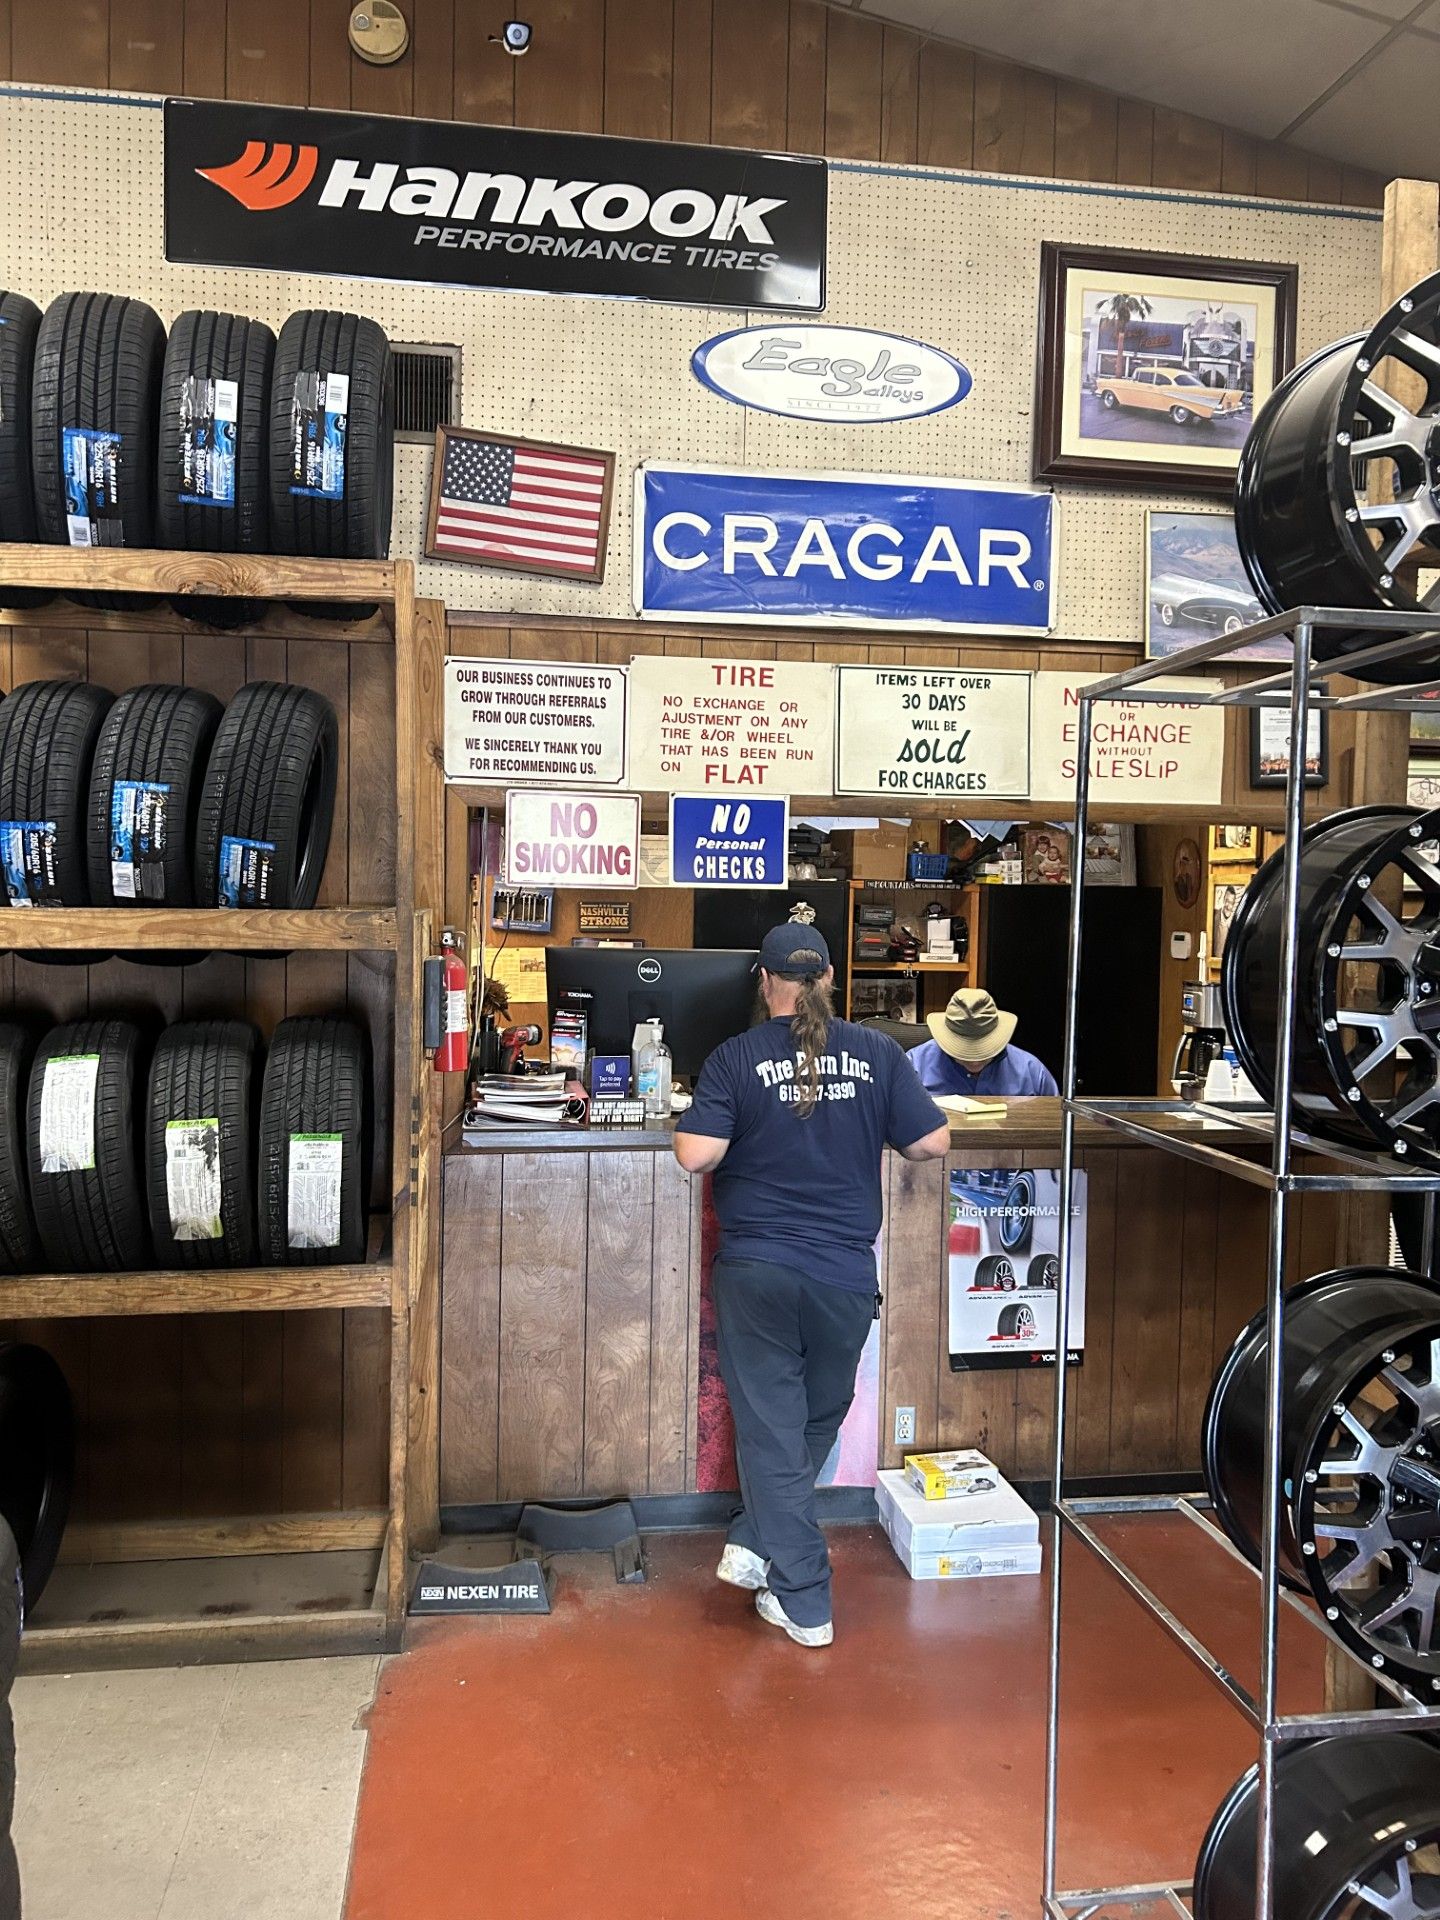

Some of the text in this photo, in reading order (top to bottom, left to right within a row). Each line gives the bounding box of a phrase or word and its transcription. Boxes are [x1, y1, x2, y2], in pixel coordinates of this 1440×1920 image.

[414, 225, 779, 272] PERFORMANCE TIRES
[742, 337, 922, 396] Eagle
[863, 385, 924, 403] alloys
[652, 512, 1031, 588] CRAGAR
[456, 670, 611, 689] OUR BUSINESS CONTINUES TO
[712, 665, 775, 688] TIRE
[876, 673, 991, 690] ITEMS LEFT OVER
[461, 690, 607, 709] GROW THROUGH REFERRALS
[663, 696, 798, 713] NO EXCHANGE OR
[902, 694, 966, 711] 30 DAYS
[472, 710, 595, 728] FROM OUR CUSTOMERS.
[661, 712, 808, 729] AJUSTMENT ON ANY
[912, 719, 957, 731] WILL BE
[1120, 712, 1135, 721] OR
[661, 728, 793, 745] TIRE &/OR WHEEL
[1063, 723, 1192, 744] ECHANGE
[465, 738, 602, 755] WE SINCERELY THANK YOU
[660, 744, 814, 761] THAT HAS BEEN RUN
[896, 729, 971, 764] sold
[1097, 747, 1152, 756] WITHOUT
[470, 758, 597, 775] FOR RECOMMENDING US.
[661, 761, 769, 785] ON FLAT
[879, 770, 986, 790] FOR CHARGES
[550, 802, 598, 839] NO
[710, 804, 751, 835] NO
[695, 836, 766, 851] Personal
[515, 841, 631, 876] SMOKING
[693, 855, 766, 881] CHECKS
[580, 908, 629, 916] NASHVILLE
[580, 917, 629, 926] STRONG
[756, 1059, 794, 1088] Tire
[841, 1051, 874, 1084] Inc.
[956, 1206, 987, 1217] HIGH
[447, 1585, 499, 1599] NEXEN
[503, 1585, 539, 1599] TIRE
